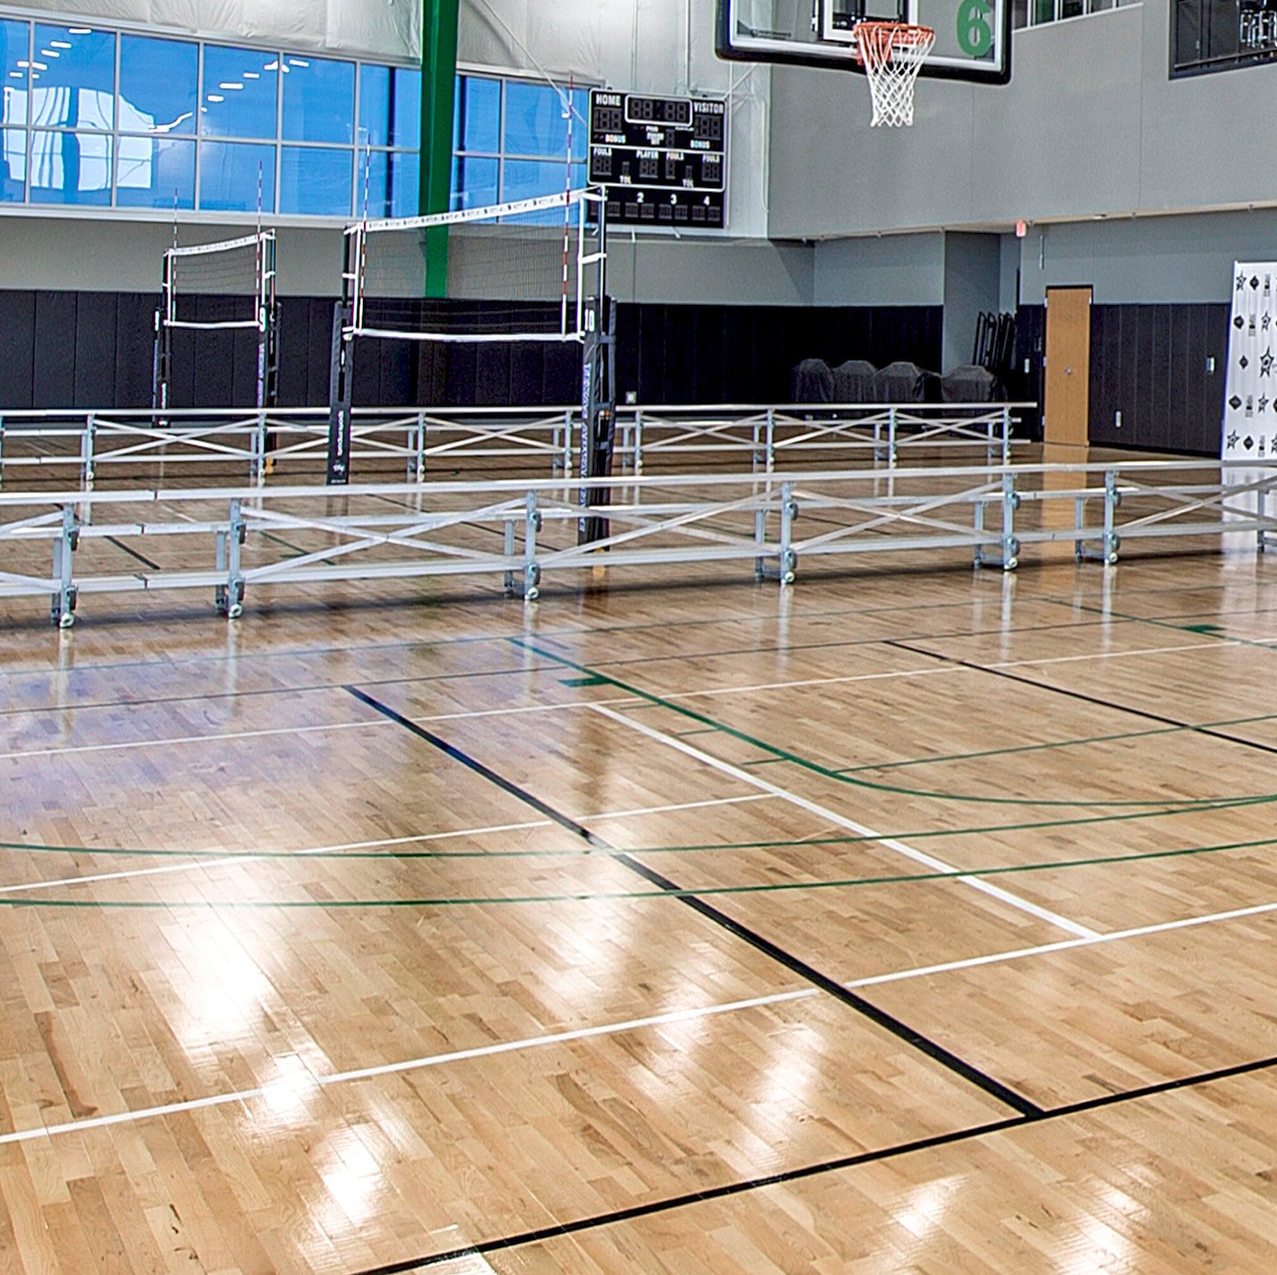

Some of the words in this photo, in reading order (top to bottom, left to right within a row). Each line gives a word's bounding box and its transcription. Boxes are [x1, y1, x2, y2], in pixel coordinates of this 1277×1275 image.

[596, 93, 621, 106] HOME
[694, 102, 723, 113] VISITOR
[605, 134, 626, 144] BONUS
[637, 192, 644, 203] 2
[670, 194, 677, 204] 3
[703, 196, 710, 206] 4
